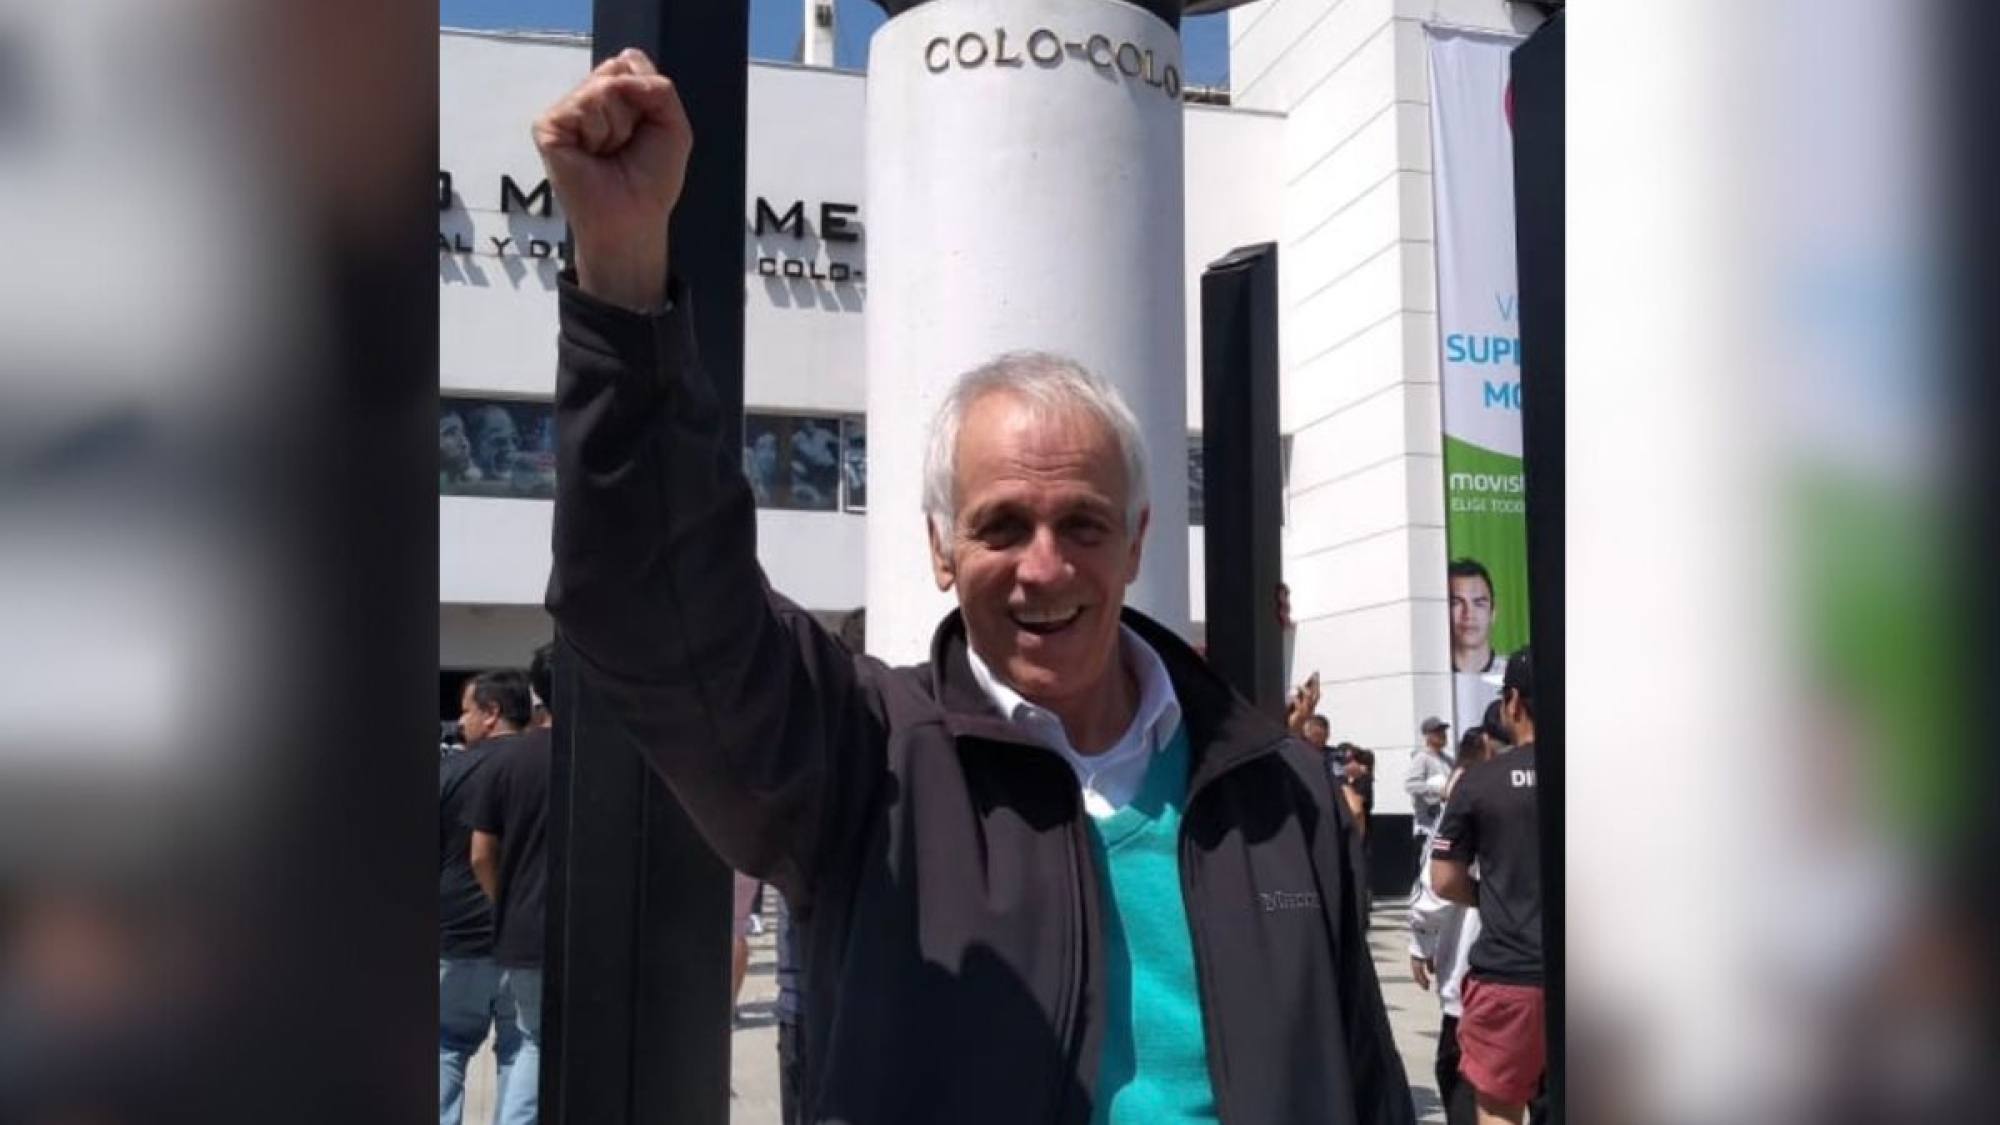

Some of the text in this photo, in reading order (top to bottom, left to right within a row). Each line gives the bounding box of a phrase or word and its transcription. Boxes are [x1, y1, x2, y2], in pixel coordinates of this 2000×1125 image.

[925, 28, 1180, 98] COLO-COLO
[755, 196, 859, 243] ME
[489, 235, 510, 258] Y
